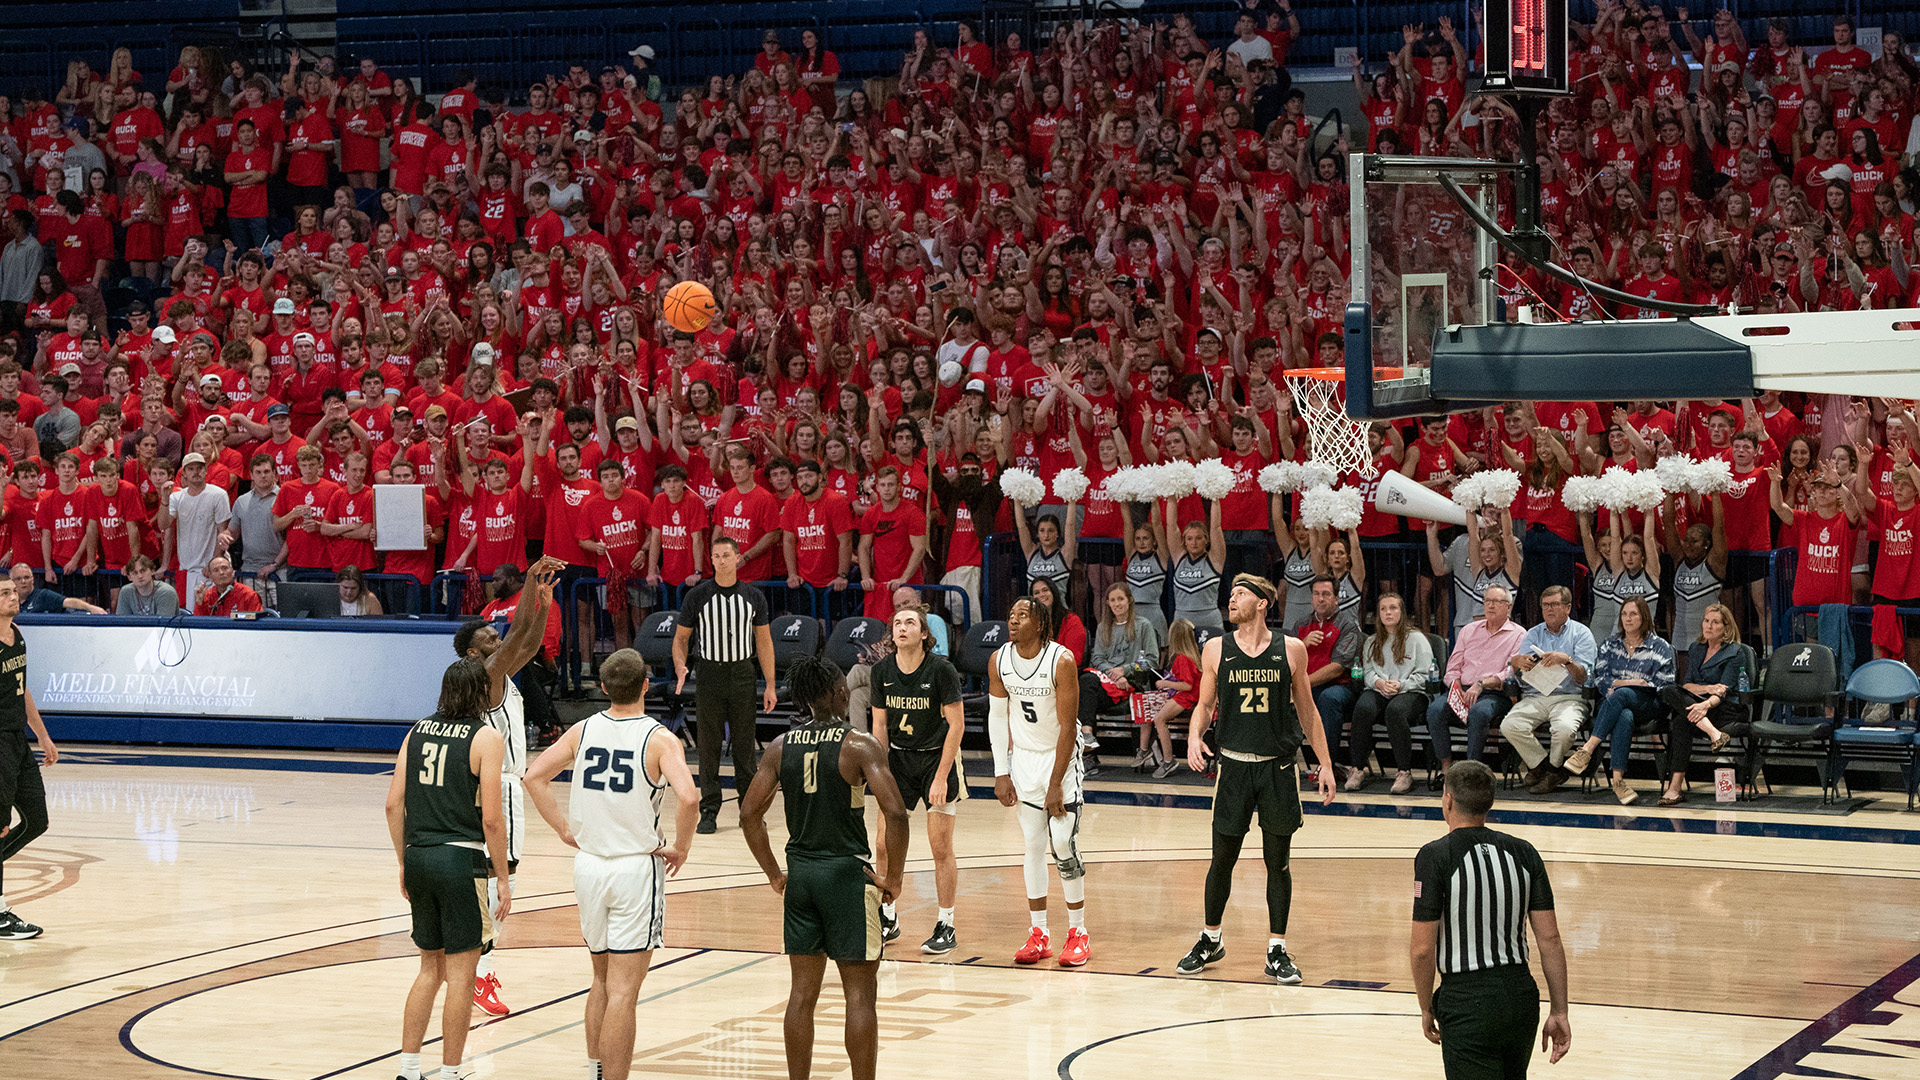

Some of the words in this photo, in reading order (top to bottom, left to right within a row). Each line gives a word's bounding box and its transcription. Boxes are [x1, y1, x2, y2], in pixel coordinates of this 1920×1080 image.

[115, 124, 137, 134] BUCK
[1374, 116, 1394, 125] BUC
[1853, 171, 1884, 182] BUCK
[1430, 217, 1452, 236] 22
[54, 351, 84, 361] BUCK
[271, 356, 291, 365] BUC
[55, 517, 82, 530] BUCK
[484, 513, 516, 529] BUCK
[602, 519, 638, 537] BUCK
[723, 516, 750, 529] BUCK
[1807, 542, 1841, 558] BUCK
[1228, 668, 1281, 683] ANDERSON
[15, 672, 25, 697] 3
[45, 672, 117, 694] MELD
[122, 674, 257, 698] FINANCIAL
[42, 693, 123, 704] INDEPENDENT
[125, 695, 171, 706] WEALTH
[174, 697, 256, 708] MANAGEMENT
[885, 695, 930, 710] ANDERSON
[1240, 687, 1270, 713] 23
[1020, 701, 1038, 723] 5
[415, 719, 472, 740] TROJANS
[899, 713, 914, 736] 4
[786, 727, 845, 745] TROJANS
[418, 741, 450, 787] 31
[583, 746, 635, 794] 25
[803, 751, 819, 794] 0
